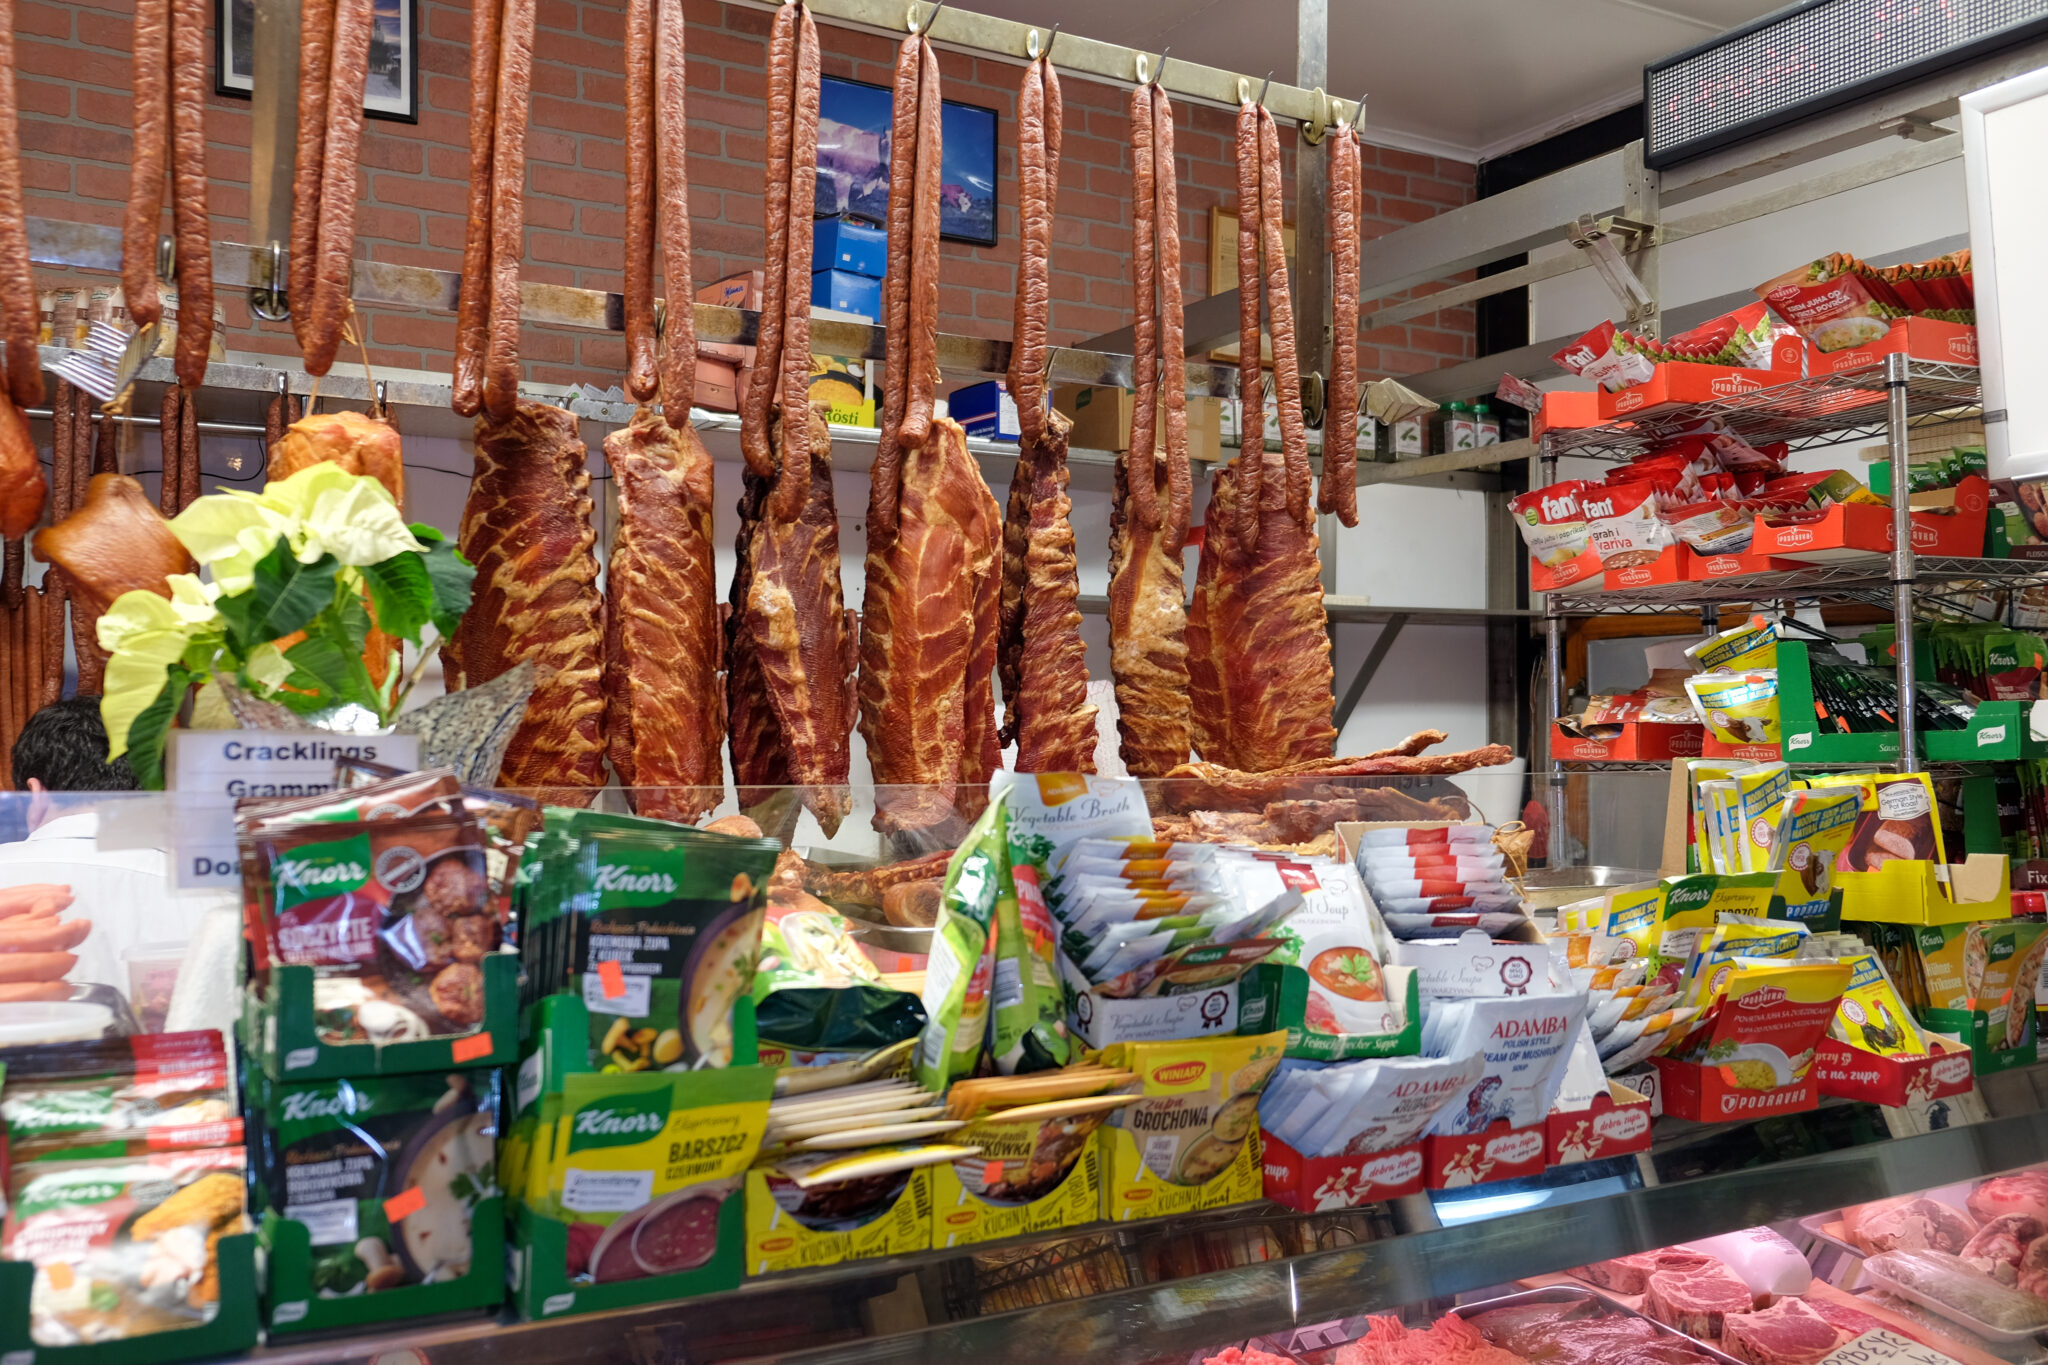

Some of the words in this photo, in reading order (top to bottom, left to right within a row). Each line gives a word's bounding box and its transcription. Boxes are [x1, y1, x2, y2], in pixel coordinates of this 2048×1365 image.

[1806, 295, 1827, 308] JUHA
[1827, 289, 1842, 300] OD
[1565, 345, 1597, 367] fant
[825, 407, 859, 425] Rösti
[1582, 497, 1615, 519] fant
[1593, 530, 1615, 542] grah
[1597, 537, 1633, 550] variva
[1989, 653, 2017, 667] Knorr
[223, 740, 377, 764] Cracklings
[226, 779, 334, 799] Gramm
[1881, 796, 1907, 806] German
[1009, 804, 1077, 829] Vegetable
[1081, 796, 1131, 820] Broth
[272, 858, 369, 887] Knorr
[594, 863, 678, 894] Knorr
[2027, 870, 2048, 884] Fix
[1669, 886, 1711, 906] Knorr
[1920, 934, 1944, 947] Knorr
[1490, 1016, 1568, 1039] ADAMBA
[1374, 1036, 1400, 1052] Suppe
[1502, 1039, 1528, 1049] POLISH
[1529, 1036, 1552, 1047] STYLE
[1484, 1053, 1507, 1063] REAM
[1508, 1051, 1520, 1062] OF
[1158, 1064, 1204, 1082] WINIARY
[1511, 1063, 1529, 1073] SOUP
[1830, 1069, 1847, 1080] na
[1850, 1069, 1881, 1084] zupę
[1739, 1089, 1807, 1110] PODRAVKA
[575, 1108, 665, 1135] Knorr
[1133, 1106, 1209, 1131] GROCHOWA
[668, 1132, 748, 1164] BARSZCZ
[1247, 1129, 1263, 1171] smak
[1084, 1150, 1099, 1193] smak
[911, 1174, 932, 1220] smak
[1157, 1185, 1202, 1212] KUCHNIA
[983, 1205, 1032, 1235] KUCHNIA
